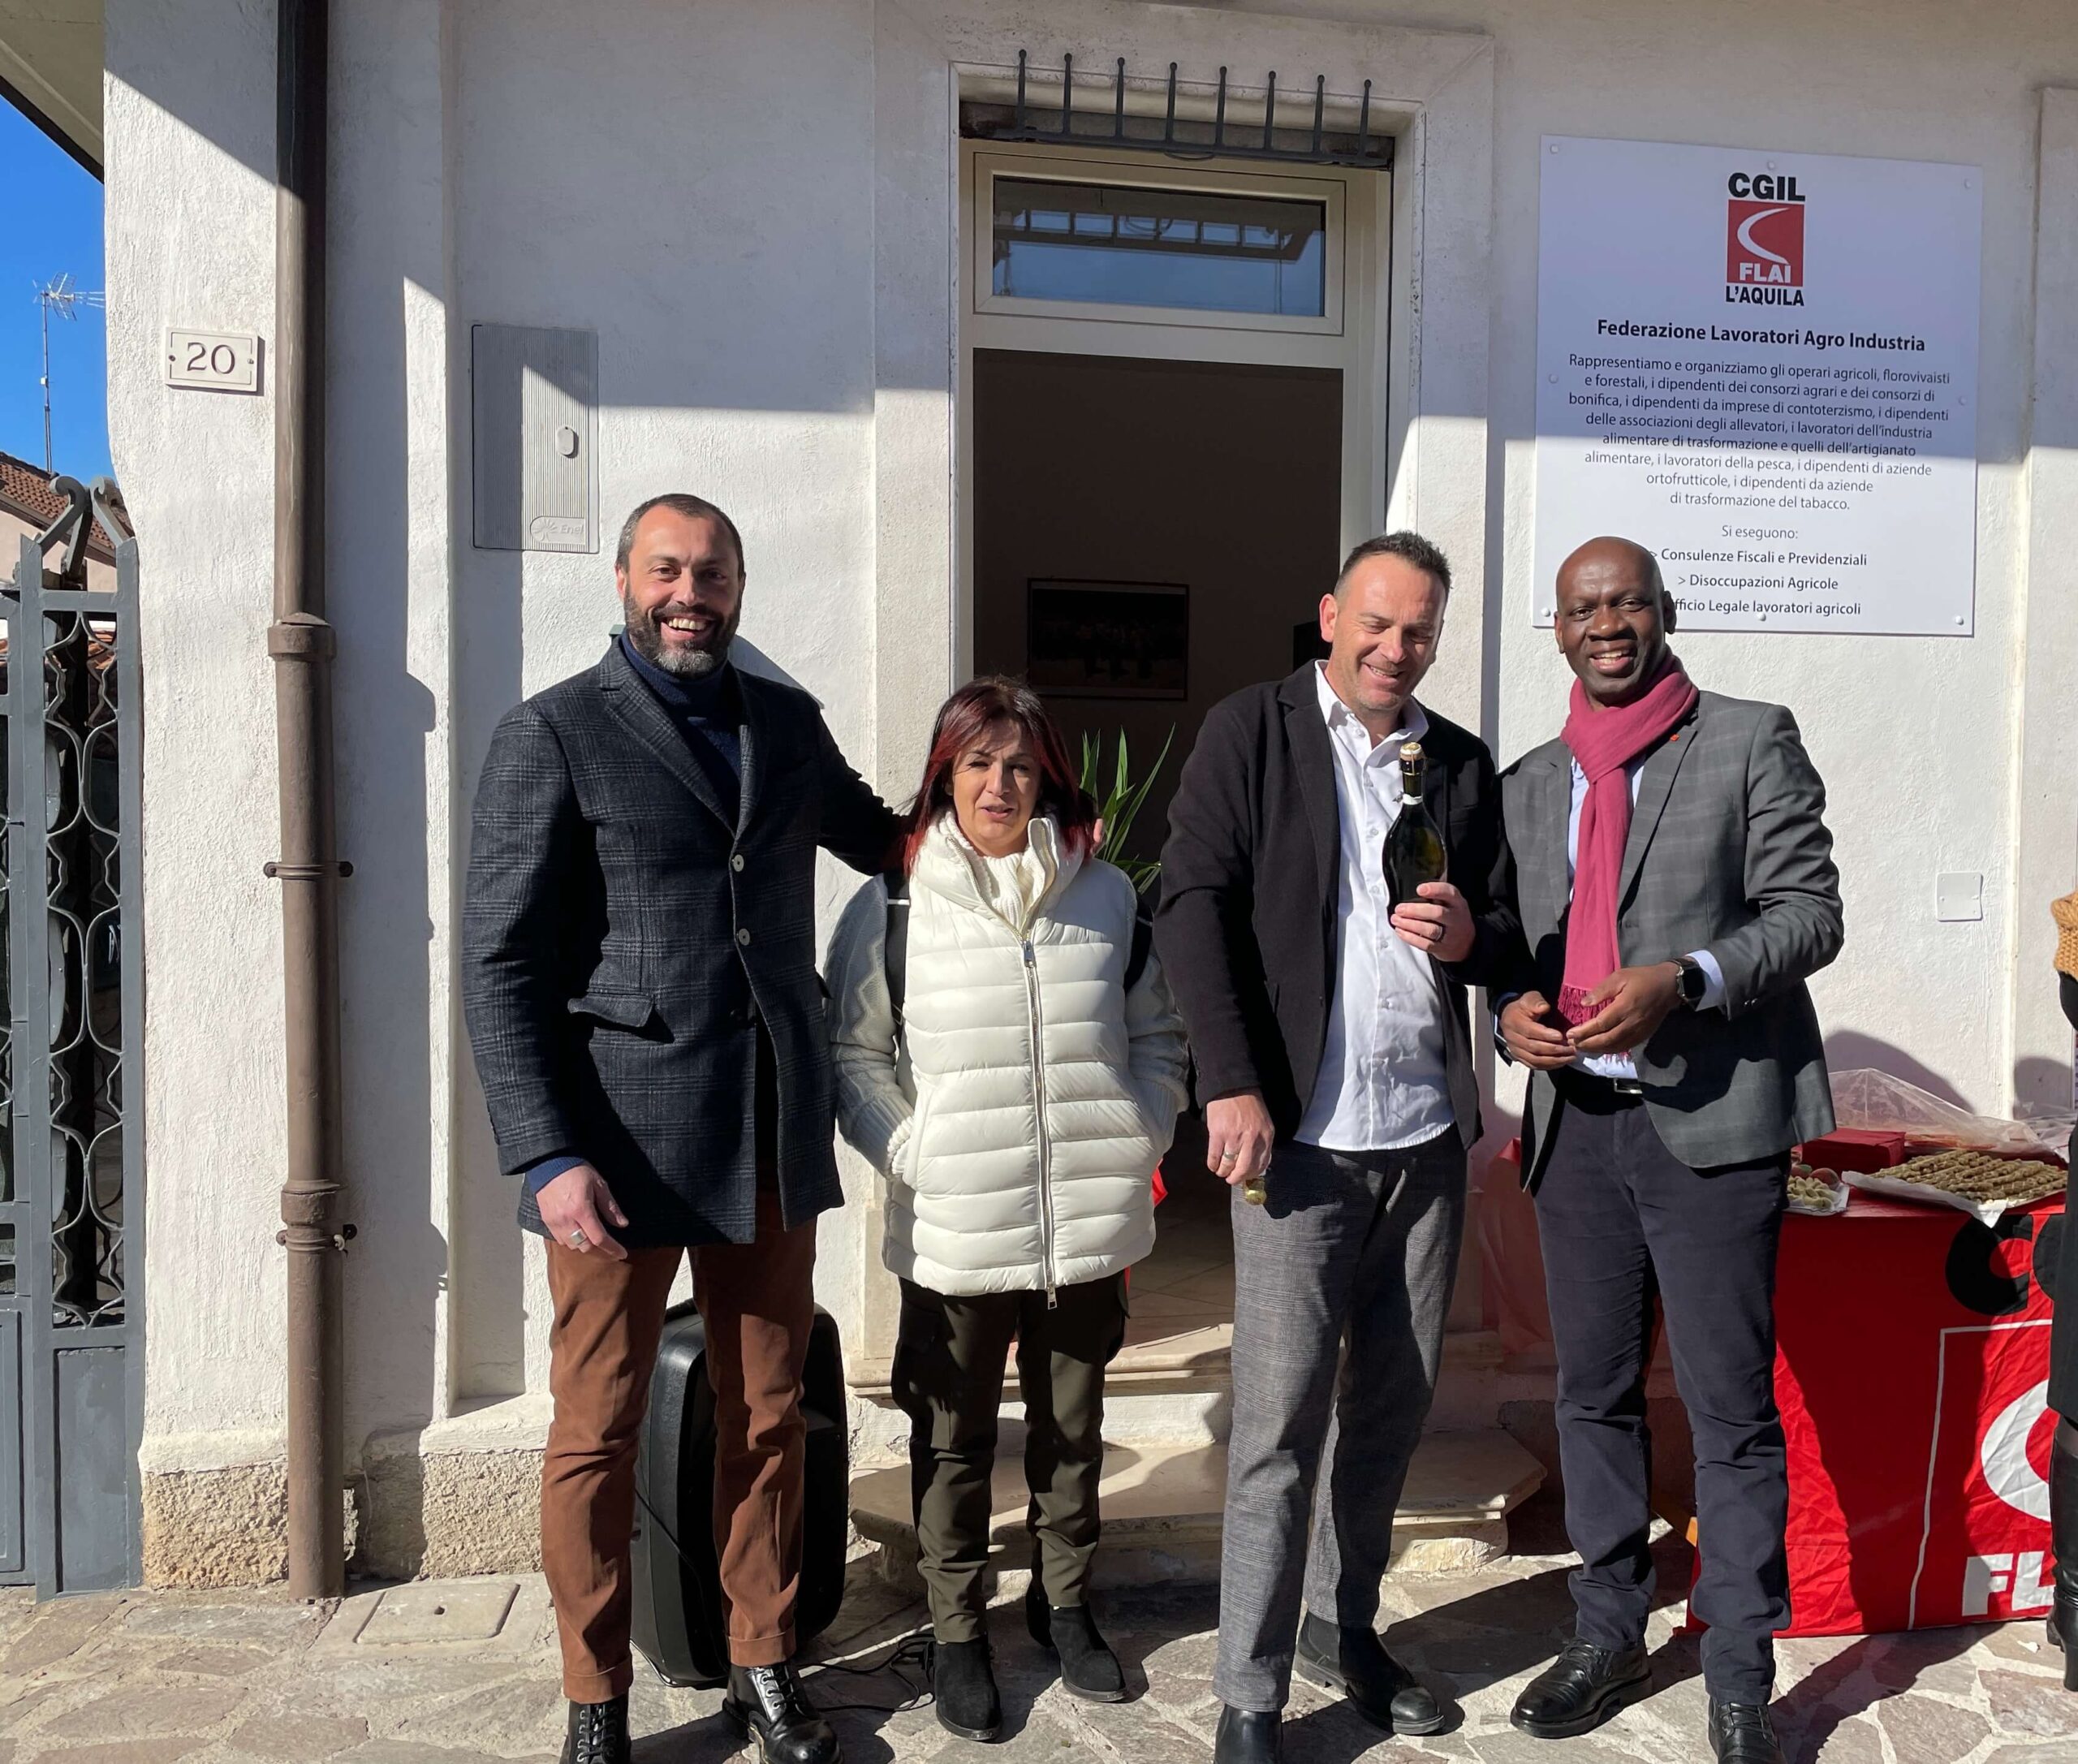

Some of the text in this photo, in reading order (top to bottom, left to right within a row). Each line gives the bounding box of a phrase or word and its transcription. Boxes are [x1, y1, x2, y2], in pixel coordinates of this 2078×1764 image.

[1728, 172, 1806, 202] CGIL
[1740, 262, 1791, 283] FLAI
[1726, 286, 1804, 307] L'AQUILA
[1597, 319, 1924, 351] Federazione Lavoratori Agro Industria
[187, 342, 235, 375] 20
[1570, 353, 1949, 383] Rappresentiamo e organizziamo gli operari agricoli, florovivaisti
[1584, 377, 1592, 386] e
[1596, 373, 1647, 390] forestali,
[1658, 377, 1724, 392] dipendenti
[1728, 380, 1747, 393] dei
[1750, 384, 1800, 395] consorzi
[1803, 386, 1836, 399] agrari
[1840, 389, 1847, 397] e
[1851, 386, 1869, 398] dei
[1872, 390, 1921, 400] consorzi
[1924, 390, 1934, 401] di
[1569, 391, 1622, 408] bonifica,
[1632, 395, 1699, 411] dipendenti
[1703, 397, 1718, 410] da
[1722, 402, 1770, 414] imprese
[1773, 401, 1783, 413] di
[1787, 404, 1875, 419] contoterzismo,
[1885, 406, 1948, 421] dipendenti
[1586, 412, 1615, 425] delle
[1619, 416, 1692, 428] associazioni
[1696, 416, 1726, 433] degli
[1729, 418, 1787, 433] allevatori,
[1798, 421, 1853, 435] lavoratori
[1857, 424, 1932, 438] dell'industria
[1602, 432, 1916, 457] alimentare di trasformazione e quelli dell'artigianato
[1584, 451, 1653, 466] alimentare,
[1664, 453, 1721, 467] lavoratori
[1725, 455, 1753, 468] della
[1757, 459, 1794, 472] pesca,
[1804, 459, 1869, 474] dipendenti
[1872, 461, 1882, 473] di
[1886, 463, 1931, 475] aziende
[1646, 472, 1730, 487] ortofrutticole,
[1740, 475, 1805, 490] dipendenti
[1809, 477, 1823, 490] da
[1826, 479, 1873, 492] aziende
[1671, 491, 1849, 509] di trasformazione del tabacco.
[560, 524, 584, 534] Enel
[1722, 524, 1797, 541] Si eseguono:
[1661, 548, 1866, 565] Consulenze Fiscali e Previdenziali
[1690, 574, 1838, 591] Disoccupazioni Agricole
[1674, 597, 1860, 617] fficio Legale lavoratori agricoli
